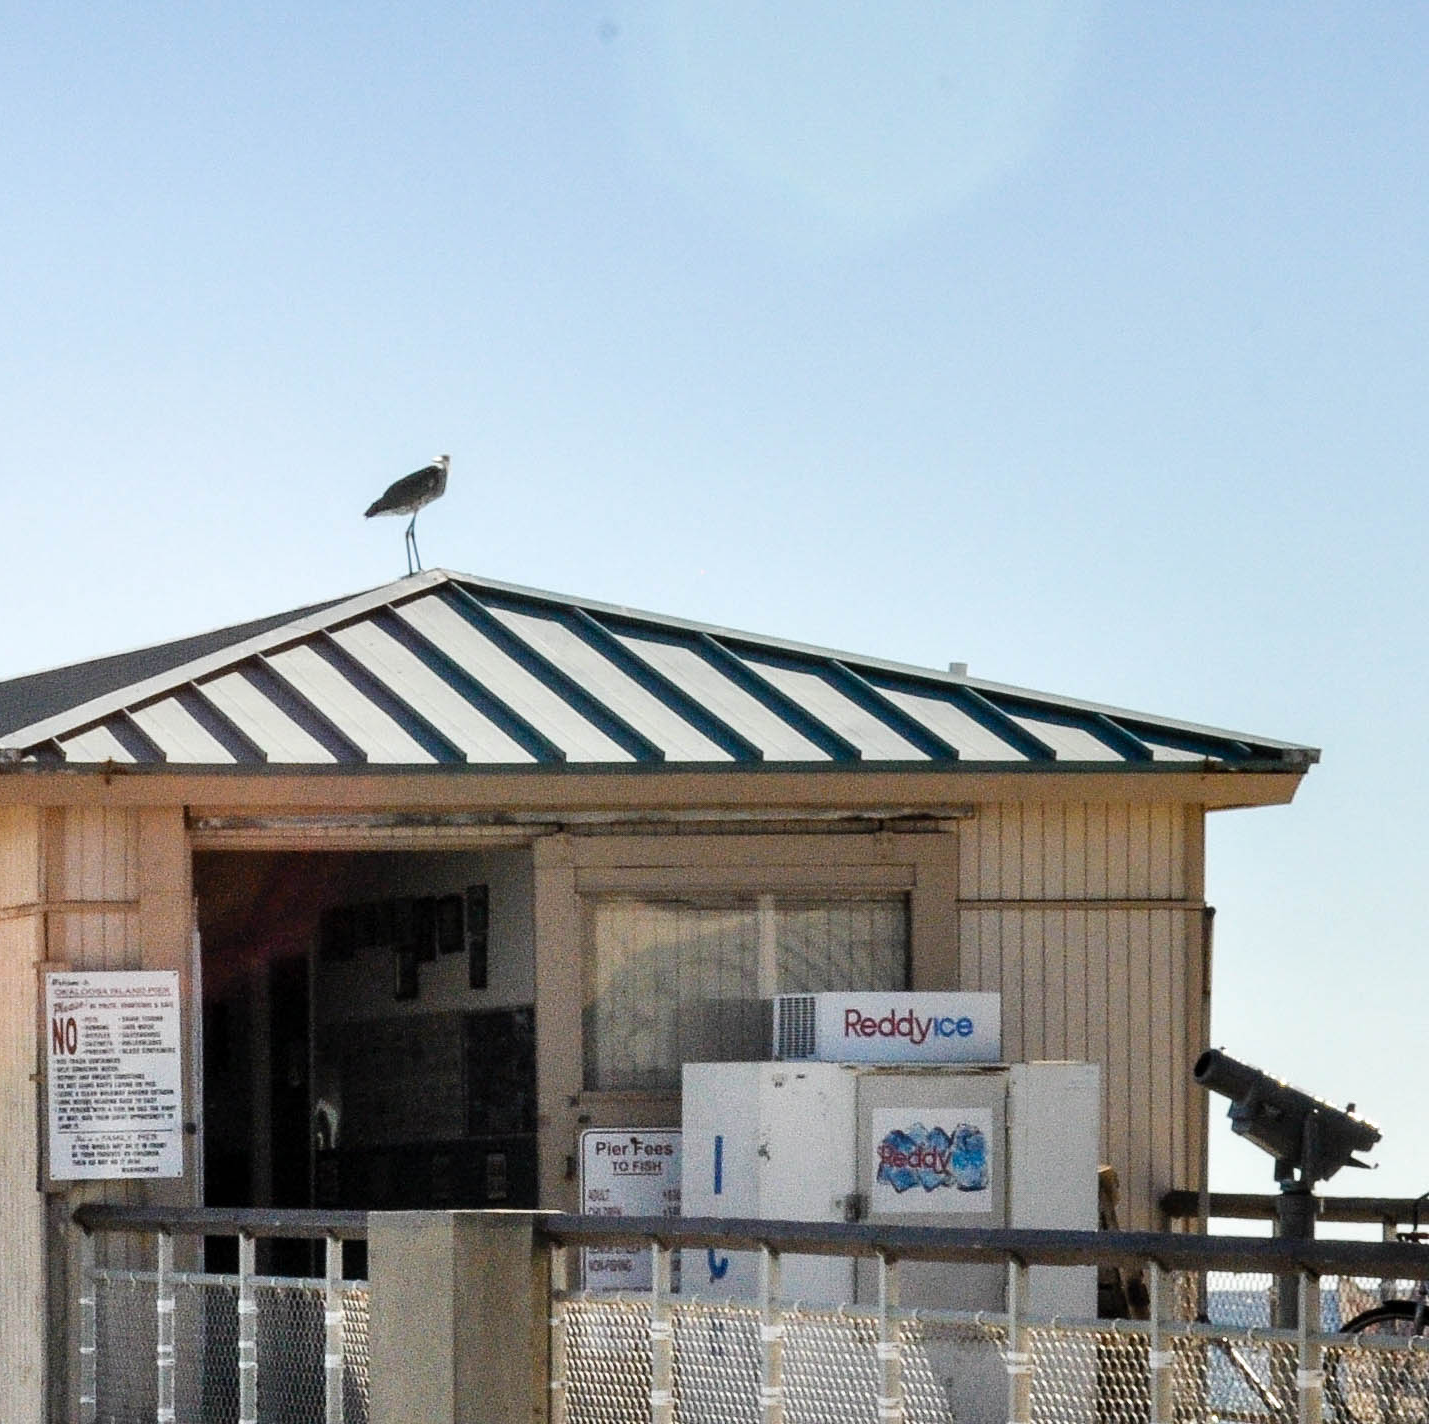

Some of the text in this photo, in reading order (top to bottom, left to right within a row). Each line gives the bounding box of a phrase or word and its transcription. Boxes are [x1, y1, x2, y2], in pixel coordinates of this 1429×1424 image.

[52, 1016, 78, 1055] NO
[595, 1140, 674, 1156] Pier Fees
[877, 1143, 952, 1175] Reddy
[612, 1160, 662, 1172] TO FISH
